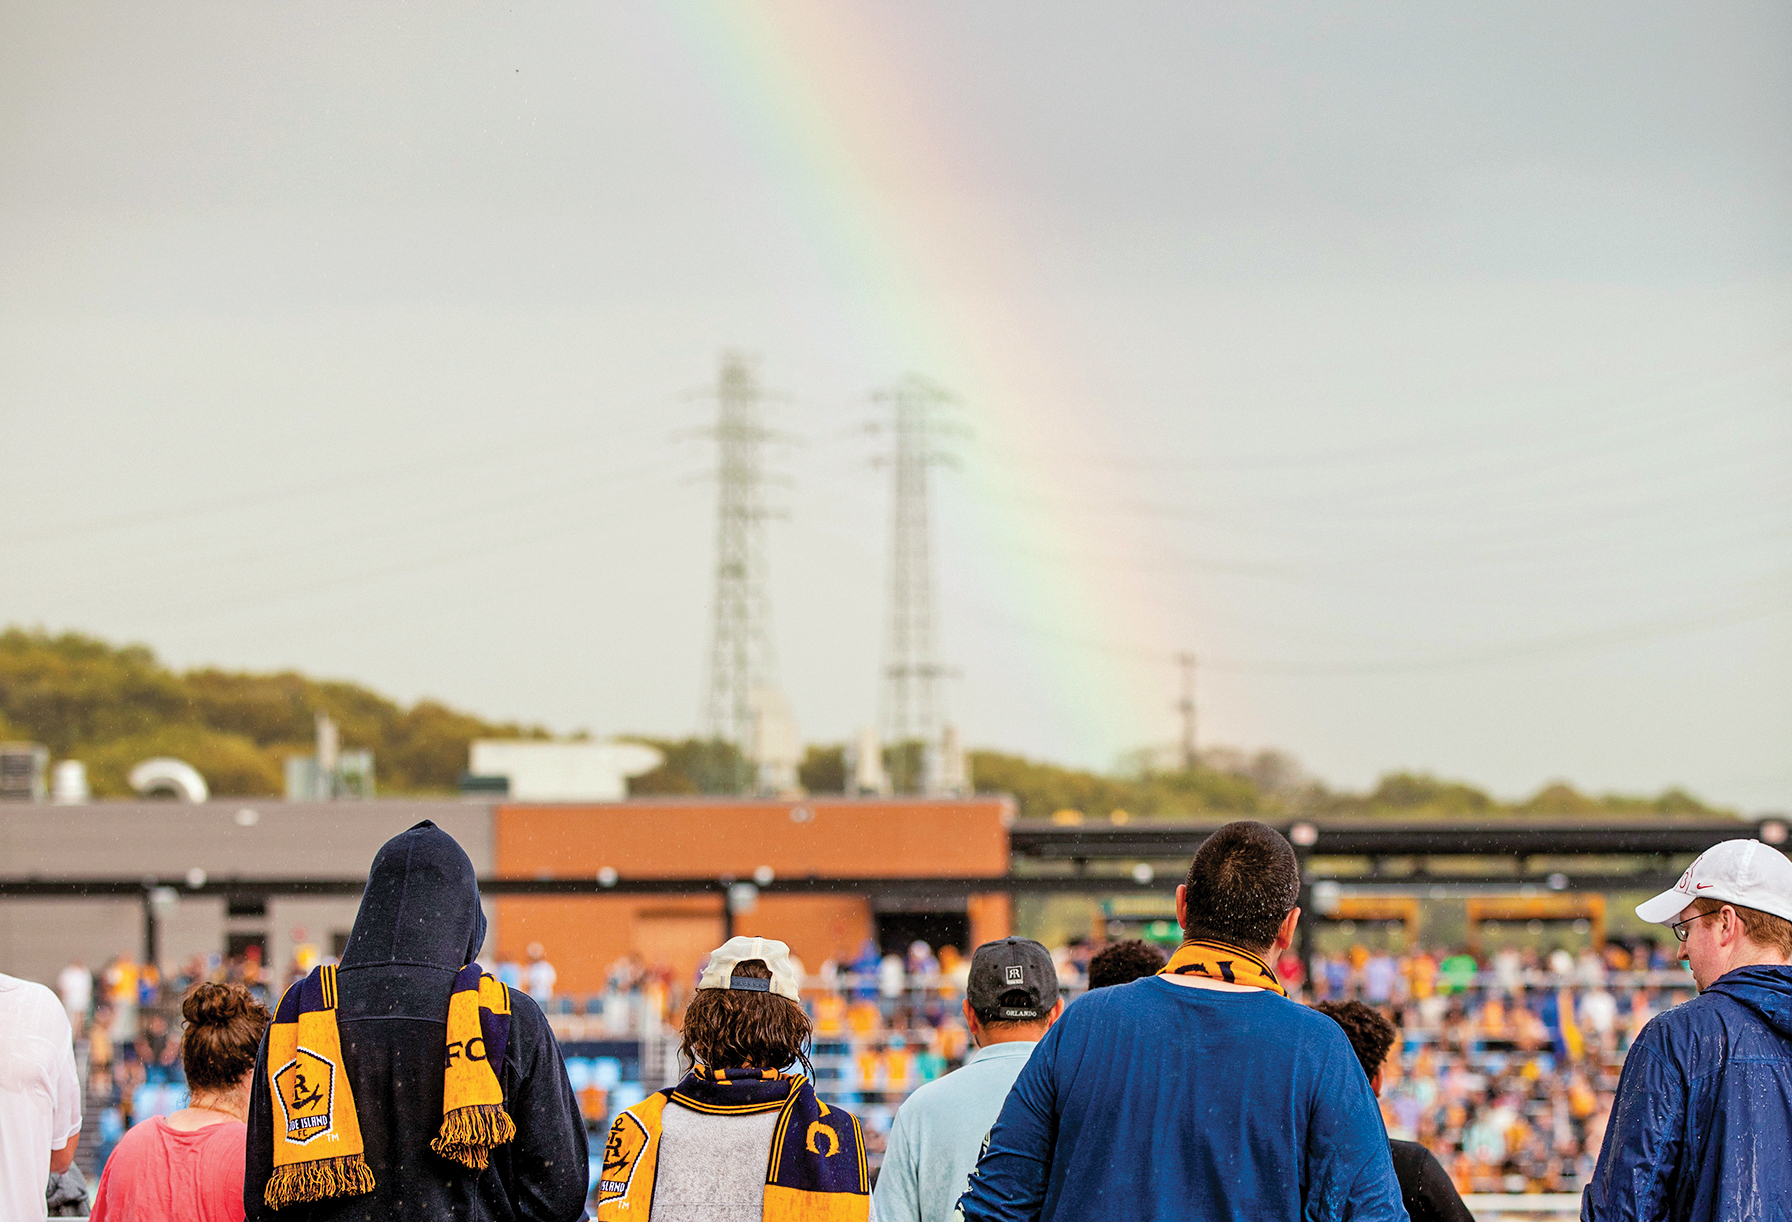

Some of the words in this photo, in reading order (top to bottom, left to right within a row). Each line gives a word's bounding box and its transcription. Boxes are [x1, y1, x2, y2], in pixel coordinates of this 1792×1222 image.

[1005, 1010, 1038, 1018] ORLANDO
[446, 1037, 487, 1069] FC
[300, 1114, 328, 1129] ISLAND
[297, 1129, 308, 1138] FC
[326, 1133, 340, 1142] TM
[618, 1200, 630, 1210] TM
